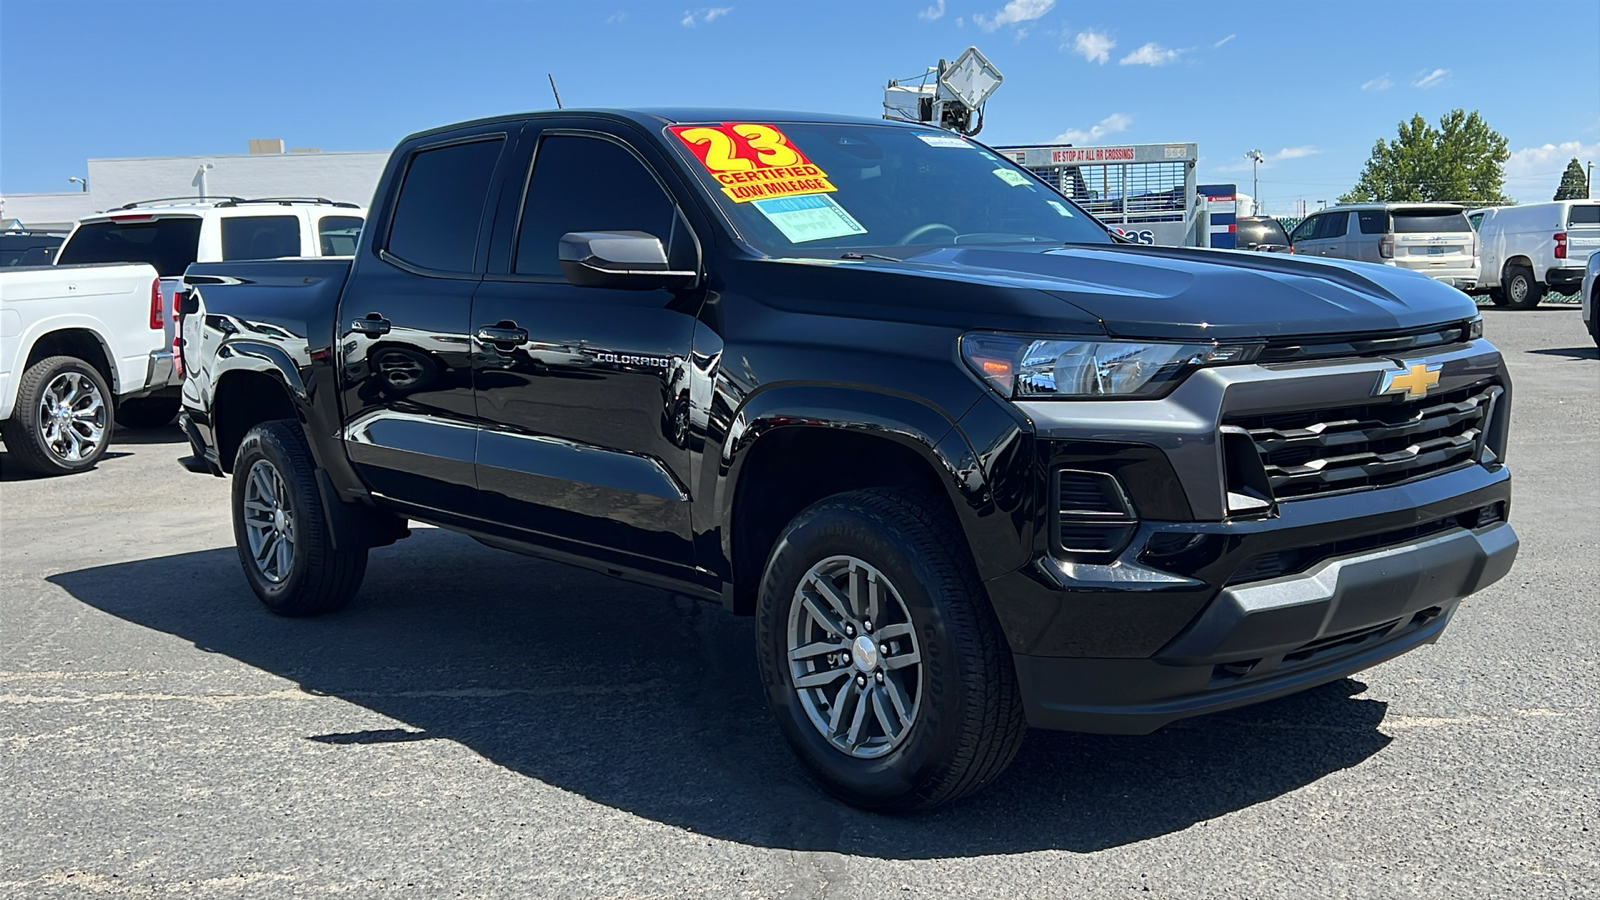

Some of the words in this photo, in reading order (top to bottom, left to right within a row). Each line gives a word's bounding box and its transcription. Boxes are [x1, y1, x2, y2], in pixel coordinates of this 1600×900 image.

[680, 124, 804, 172] 23
[1053, 151, 1061, 162] WE
[1062, 150, 1076, 162] STOP
[1077, 150, 1084, 161] AT
[1086, 149, 1095, 161] ALL
[1096, 149, 1103, 160] RR
[1104, 148, 1134, 160] CROSSINGS
[718, 166, 819, 185] CERTIFIED
[730, 184, 765, 200] LOW
[767, 179, 826, 195] MILEAGE
[597, 353, 669, 368] COLORADO
